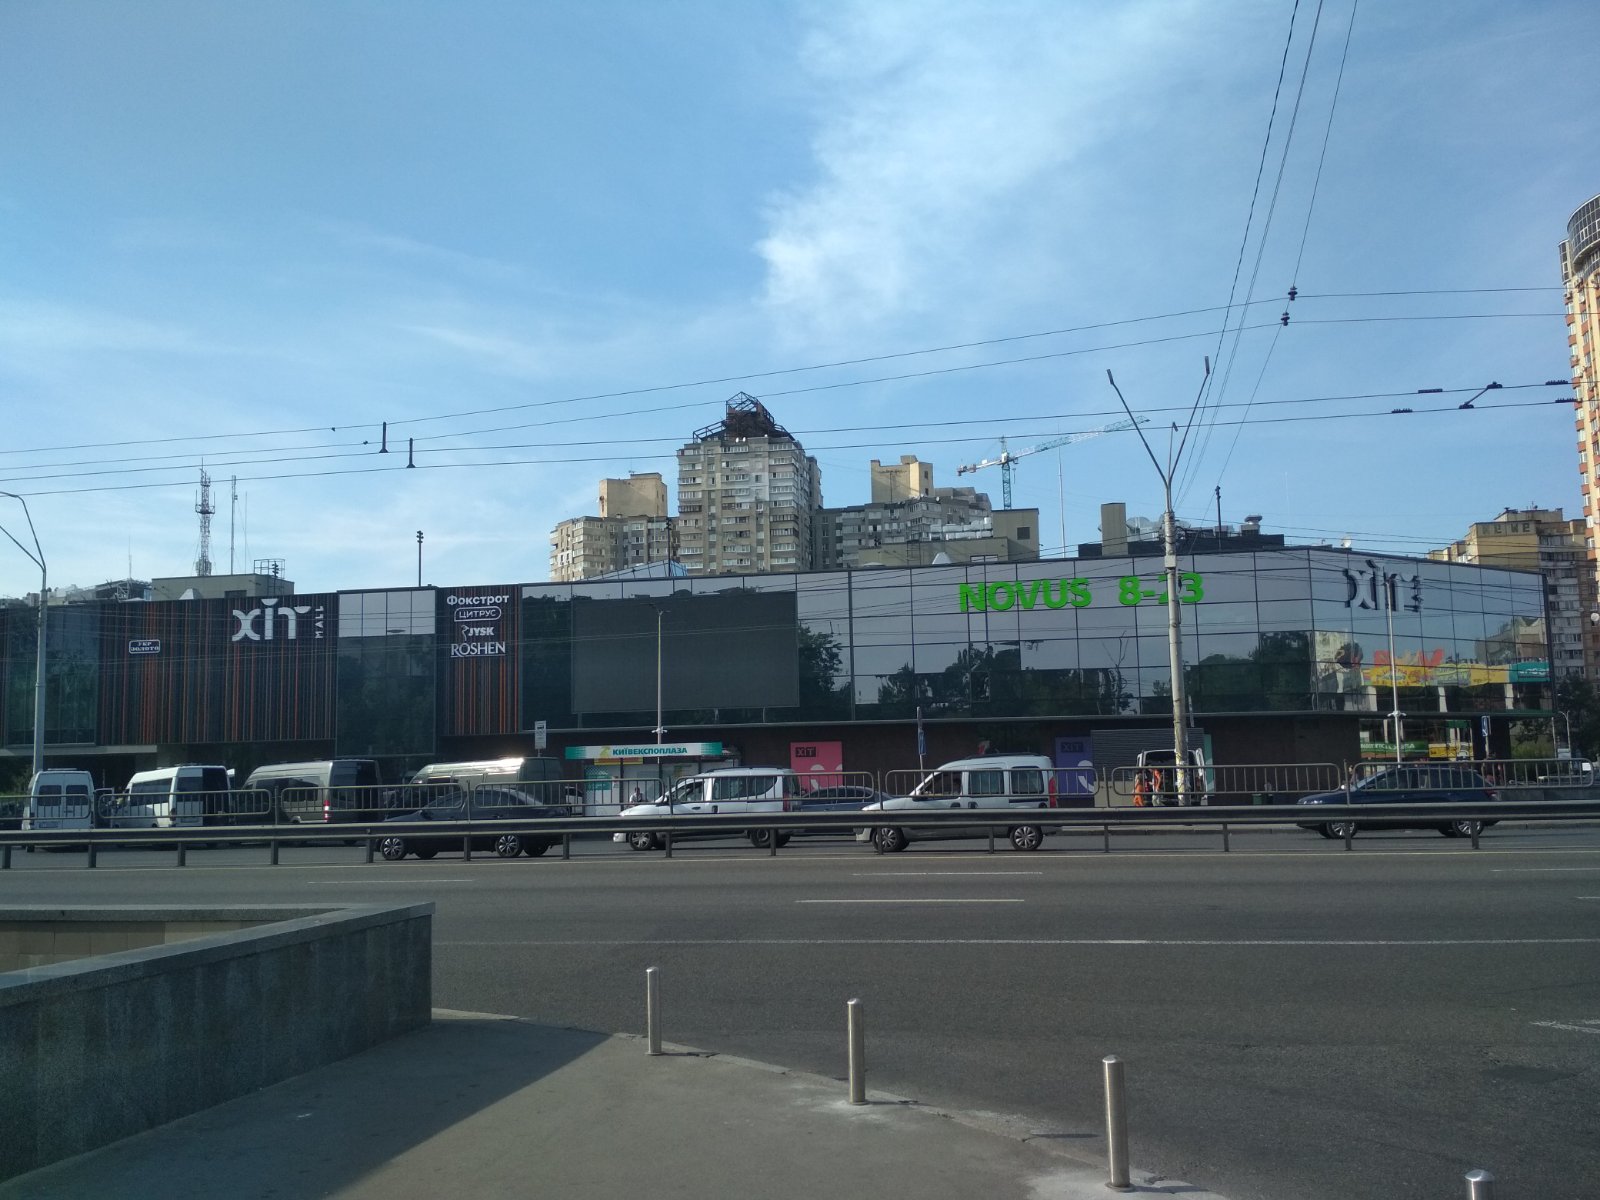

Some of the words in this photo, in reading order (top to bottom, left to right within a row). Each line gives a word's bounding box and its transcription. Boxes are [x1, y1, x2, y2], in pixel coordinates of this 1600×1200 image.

[446, 594, 510, 606] Фокстрот
[958, 577, 1092, 612] NOVUS
[458, 609, 497, 618] ЦИТРУС
[315, 605, 324, 639] MALL
[468, 626, 495, 637] JYSK
[450, 641, 507, 657] ROSHEN
